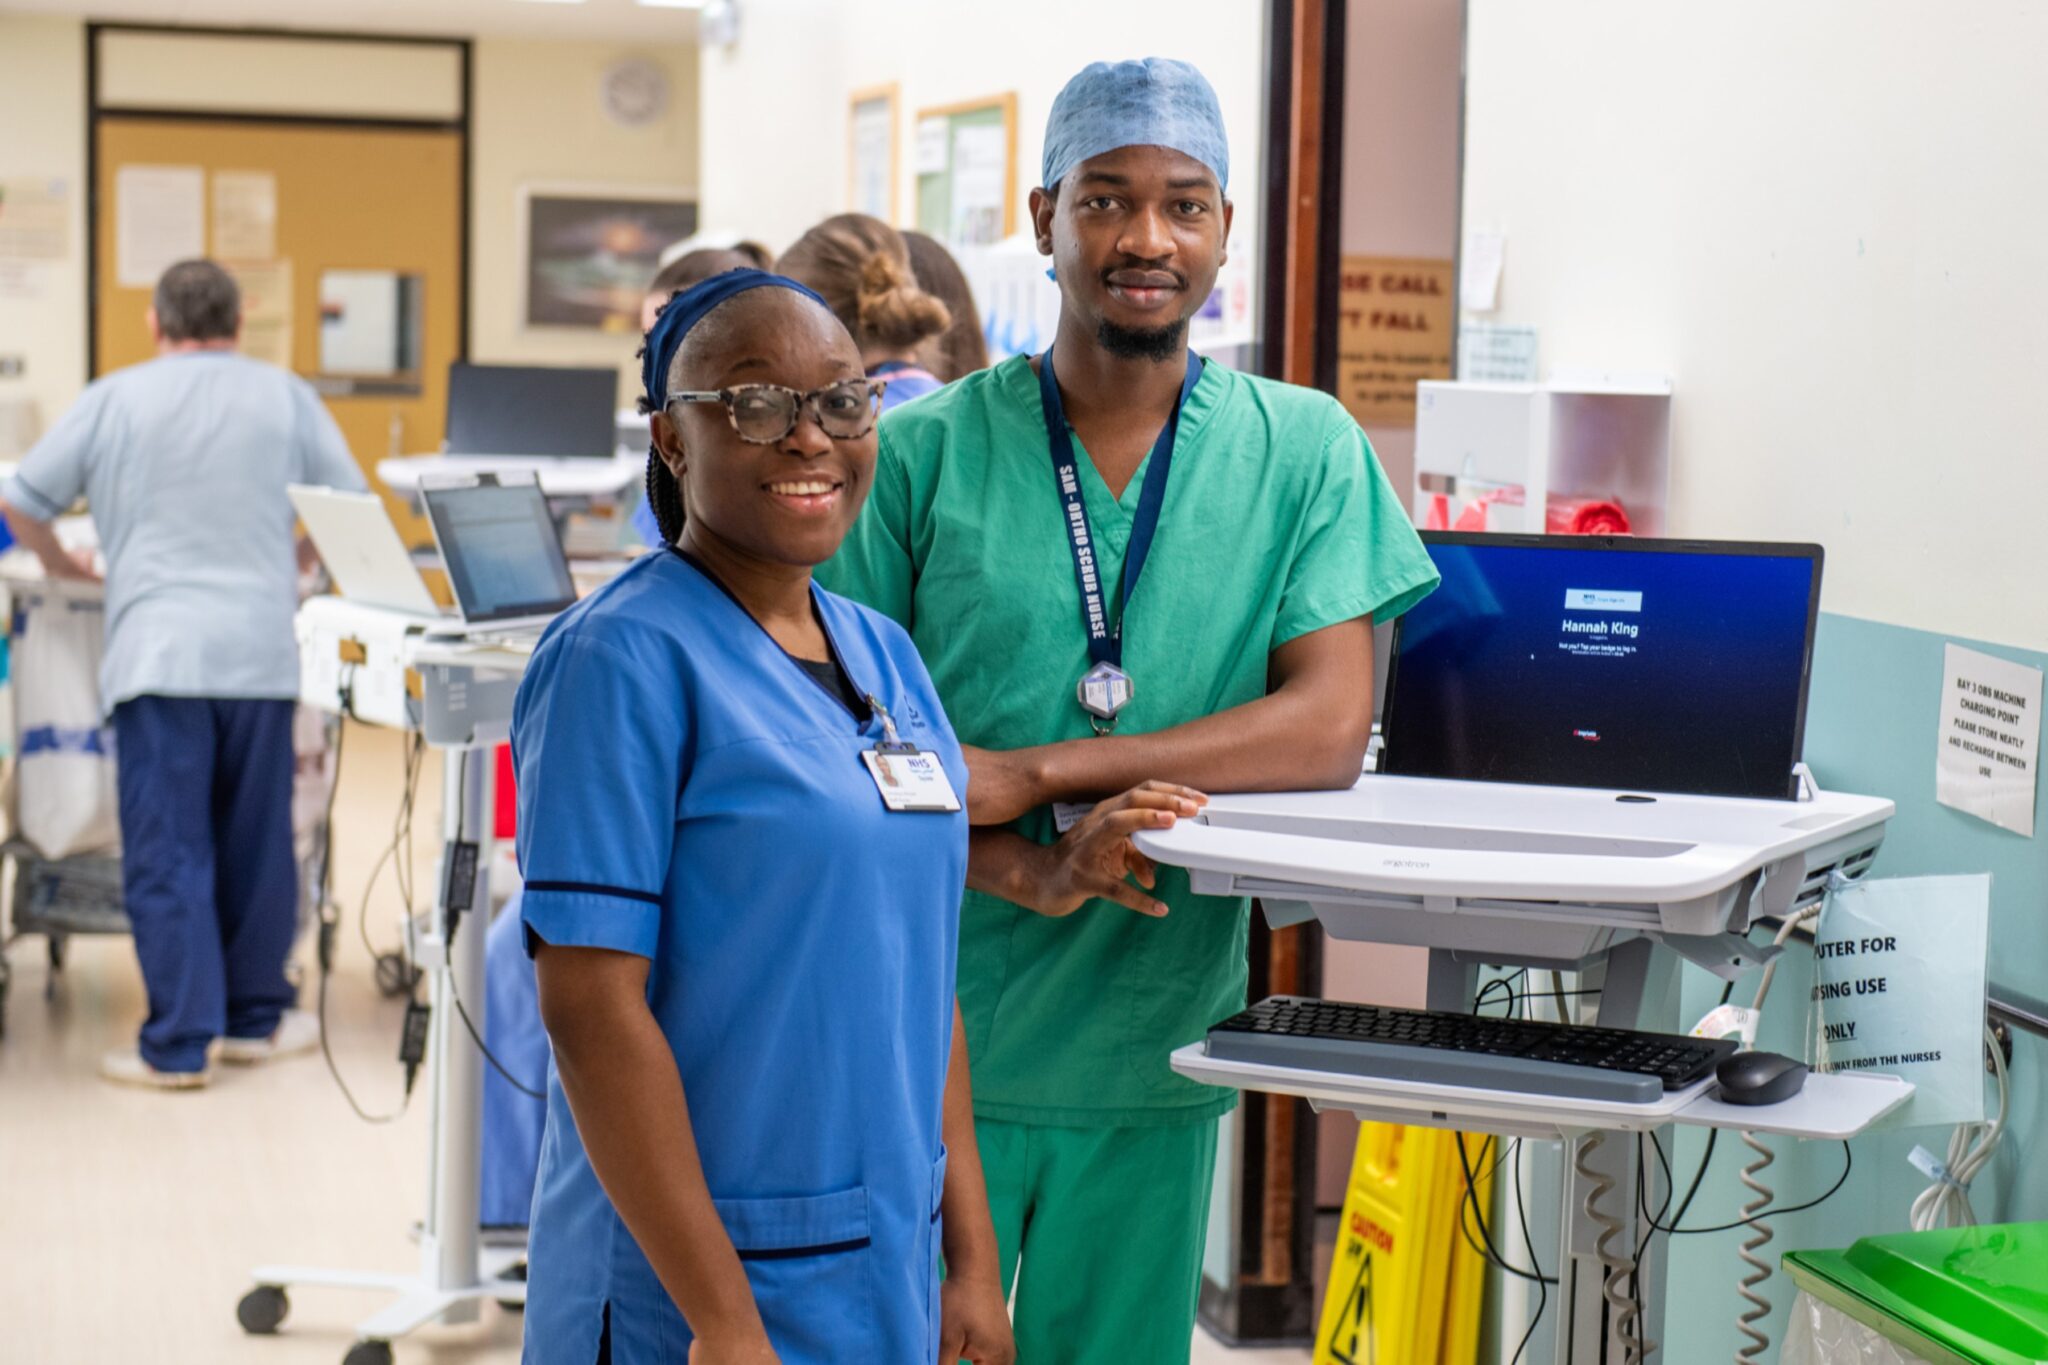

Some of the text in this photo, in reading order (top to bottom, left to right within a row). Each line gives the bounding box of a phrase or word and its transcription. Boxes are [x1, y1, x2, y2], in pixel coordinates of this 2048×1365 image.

[1340, 275, 1443, 297] SE CALL
[1369, 311, 1430, 333] FALL
[1059, 464, 1077, 494] SAM
[1067, 502, 1089, 545] ORTHO
[1077, 547, 1097, 592] SCRUB
[1086, 593, 1106, 639] NURSE
[1562, 619, 1639, 638] Hannah King
[1957, 677, 1970, 691] BAY
[1978, 684, 1992, 699] OBS
[1993, 688, 2026, 709] MACHINE
[1960, 698, 2019, 726] CHARGING POINT
[1954, 718, 2024, 749] PLEASE STORE NEATLY
[907, 758, 930, 768] NHS
[1948, 735, 2026, 770] AND RECHARGE BETWEEN
[1979, 765, 1991, 778] USE
[1861, 937, 1897, 954] FOR
[1855, 978, 1887, 995] USE
[1824, 1022, 1856, 1040] ONLY
[1852, 1057, 1877, 1069] FROM
[1880, 1054, 1898, 1066] THE
[1901, 1051, 1941, 1063] NURSES
[1351, 1211, 1393, 1255] CAUTION
